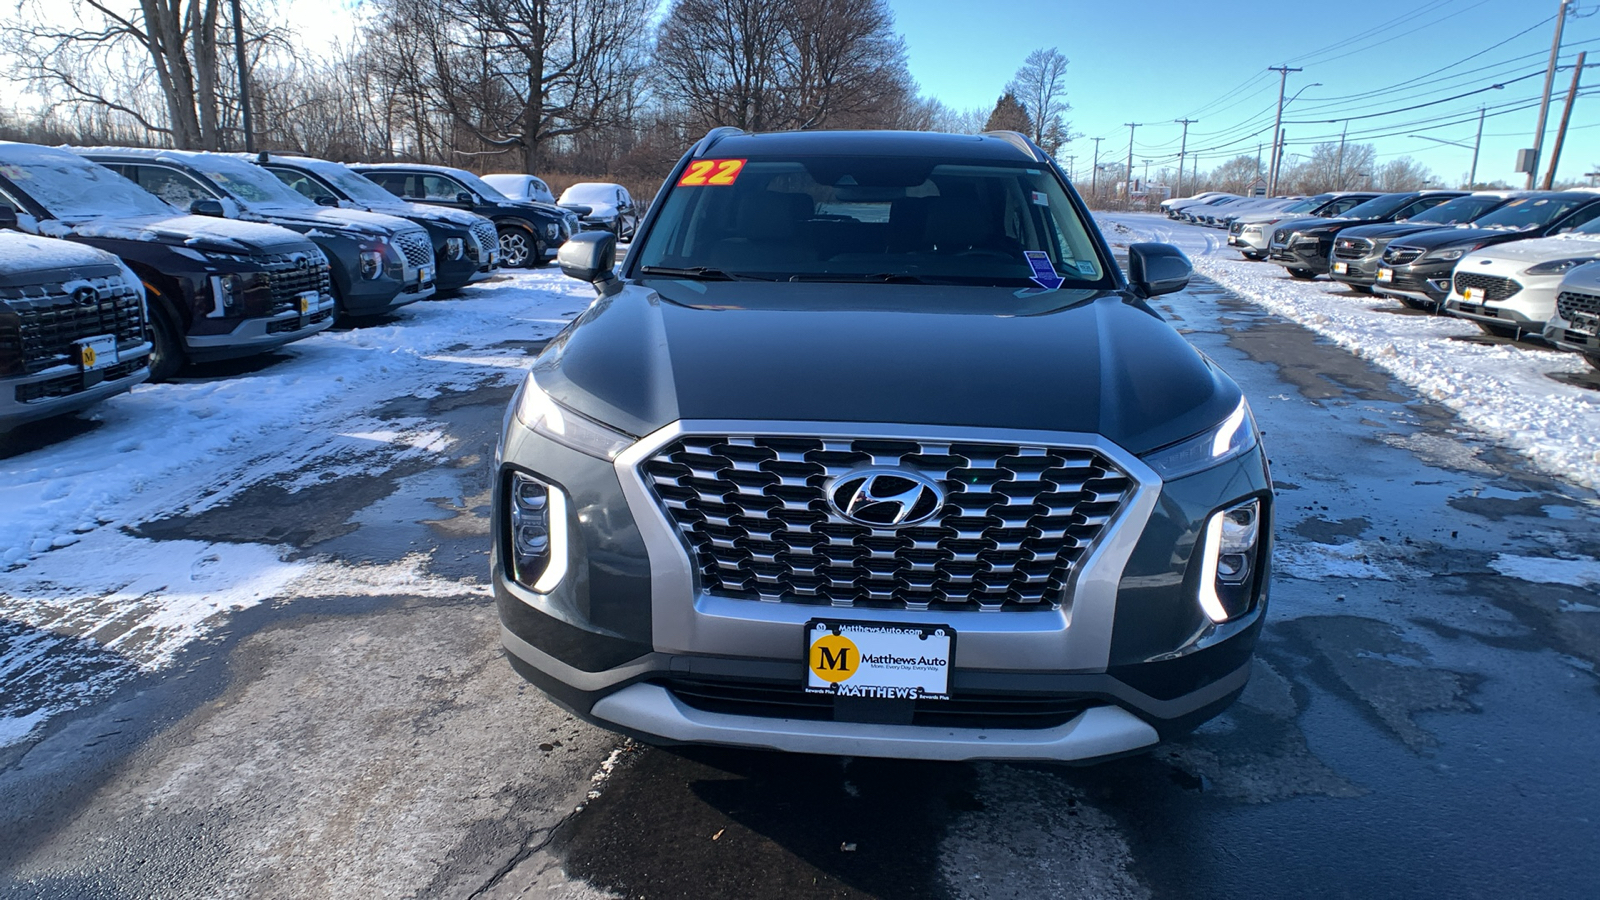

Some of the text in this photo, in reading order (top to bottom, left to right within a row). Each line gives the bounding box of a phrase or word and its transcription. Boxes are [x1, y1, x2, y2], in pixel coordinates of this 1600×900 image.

[681, 159, 742, 185] 22
[85, 352, 93, 363] M
[838, 624, 923, 636] MatthewsAuto.com
[816, 646, 851, 671] M
[861, 653, 947, 667] Matthews Auto
[837, 684, 918, 700] MATTHEWS
